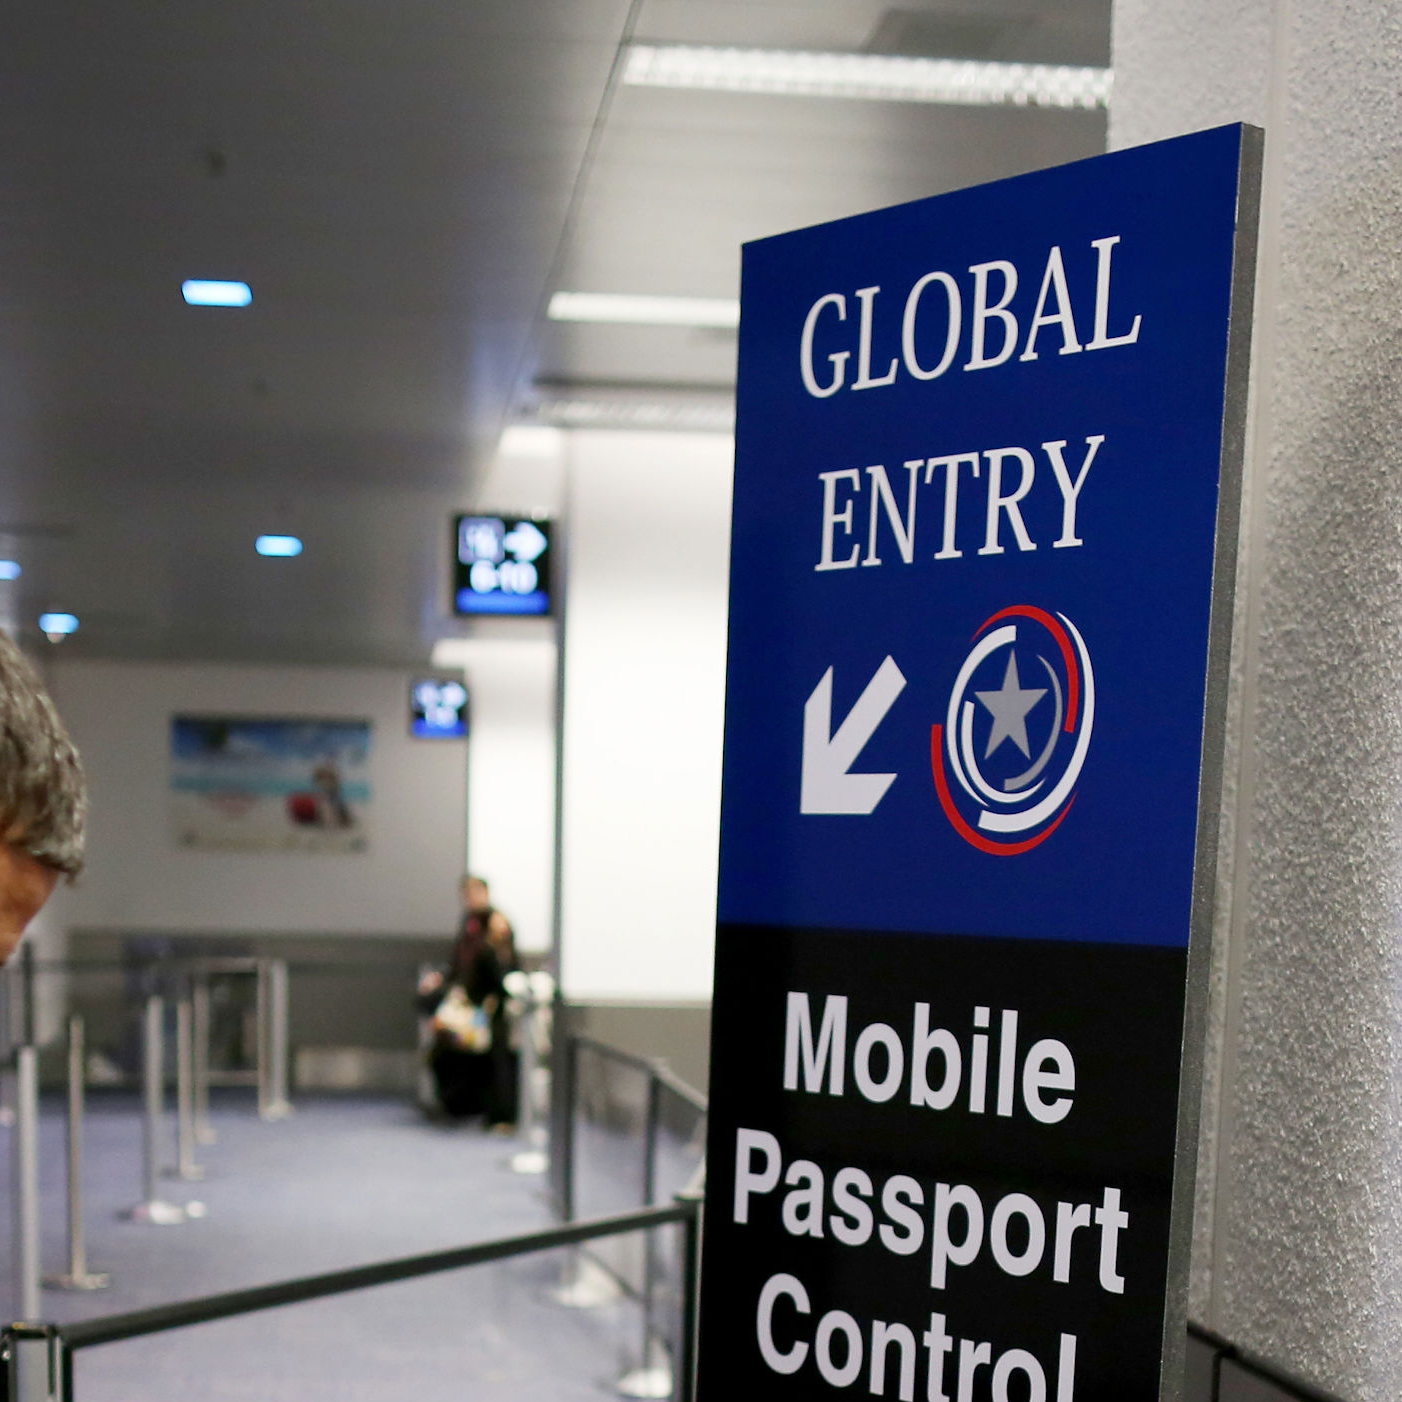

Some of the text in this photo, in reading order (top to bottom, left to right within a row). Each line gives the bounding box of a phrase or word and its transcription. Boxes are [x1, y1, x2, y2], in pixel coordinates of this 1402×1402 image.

[799, 235, 1142, 398] GLOBAL
[814, 434, 1105, 571] ENTRY
[783, 990, 1076, 1124] Mobile
[733, 1127, 1129, 1295] Passport
